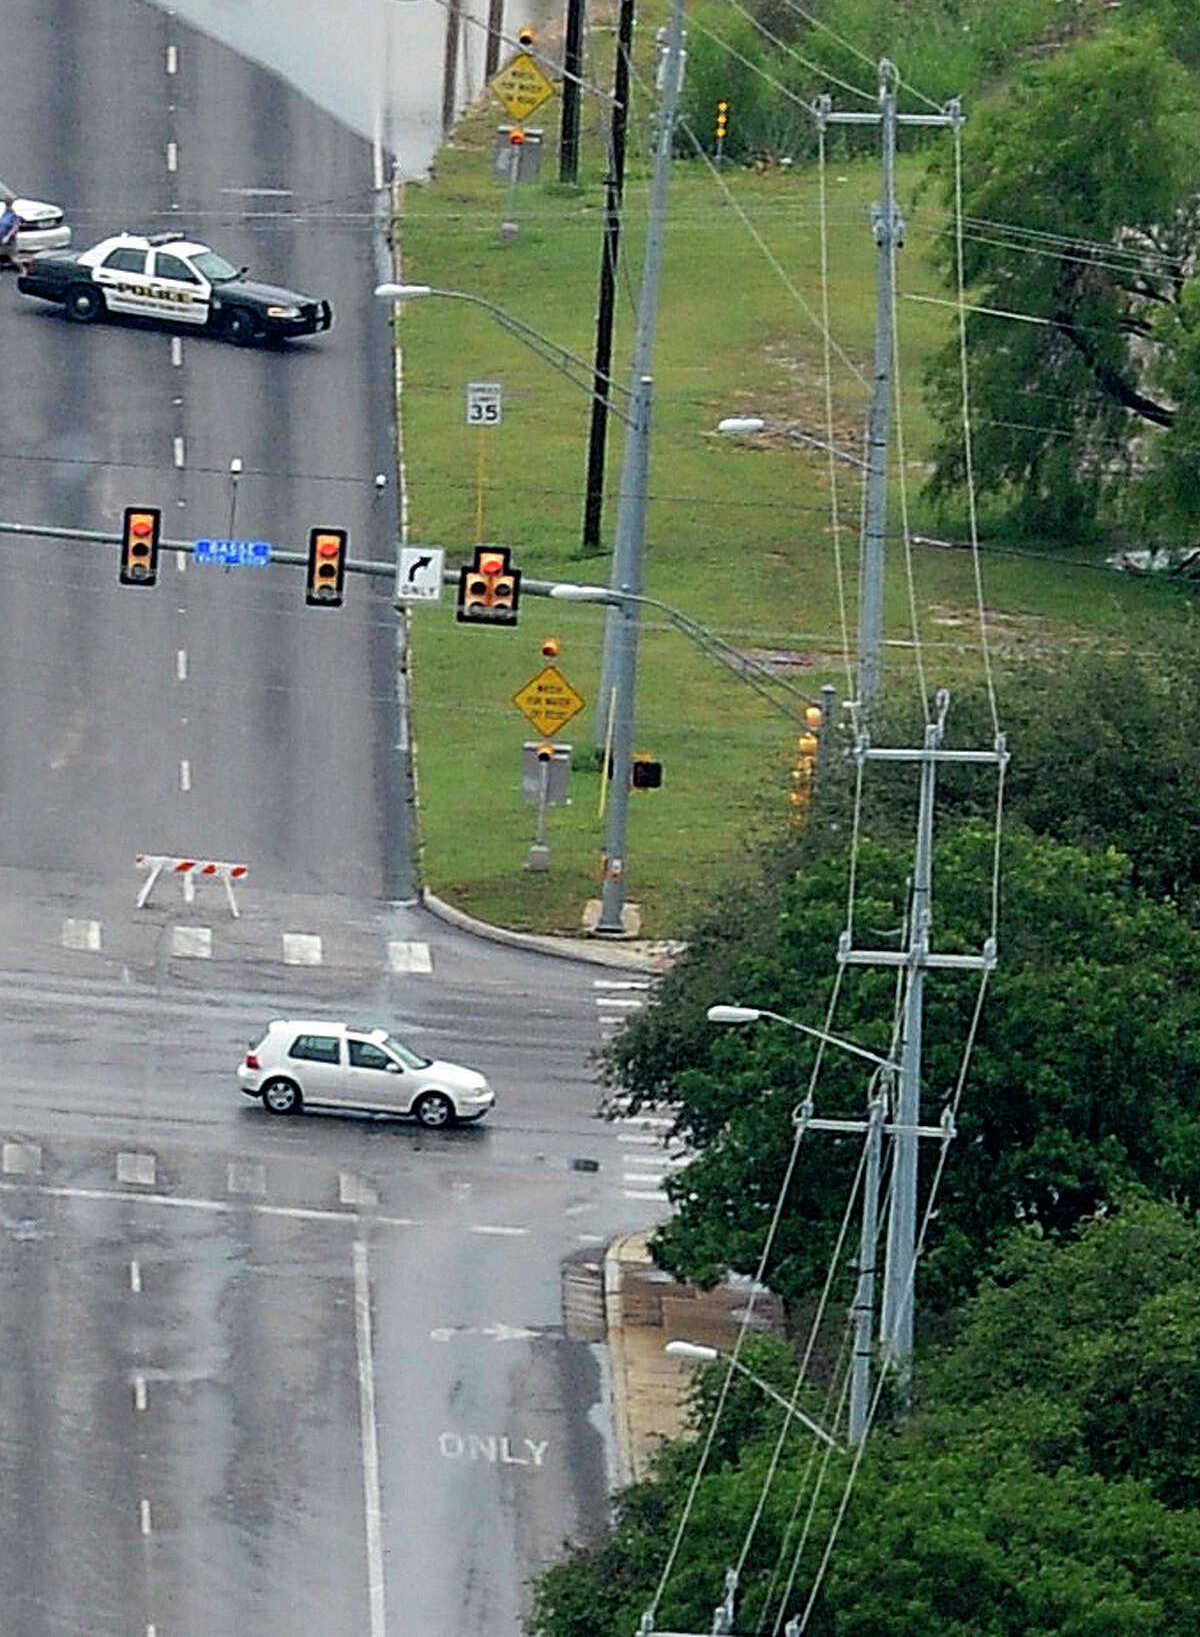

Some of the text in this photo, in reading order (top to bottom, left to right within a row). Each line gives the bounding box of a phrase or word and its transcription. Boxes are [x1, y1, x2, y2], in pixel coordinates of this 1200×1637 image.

[117, 282, 189, 303] POLICE
[471, 405, 497, 420] 35
[402, 584, 434, 596] ONLY
[438, 1431, 549, 1466] ONLY
